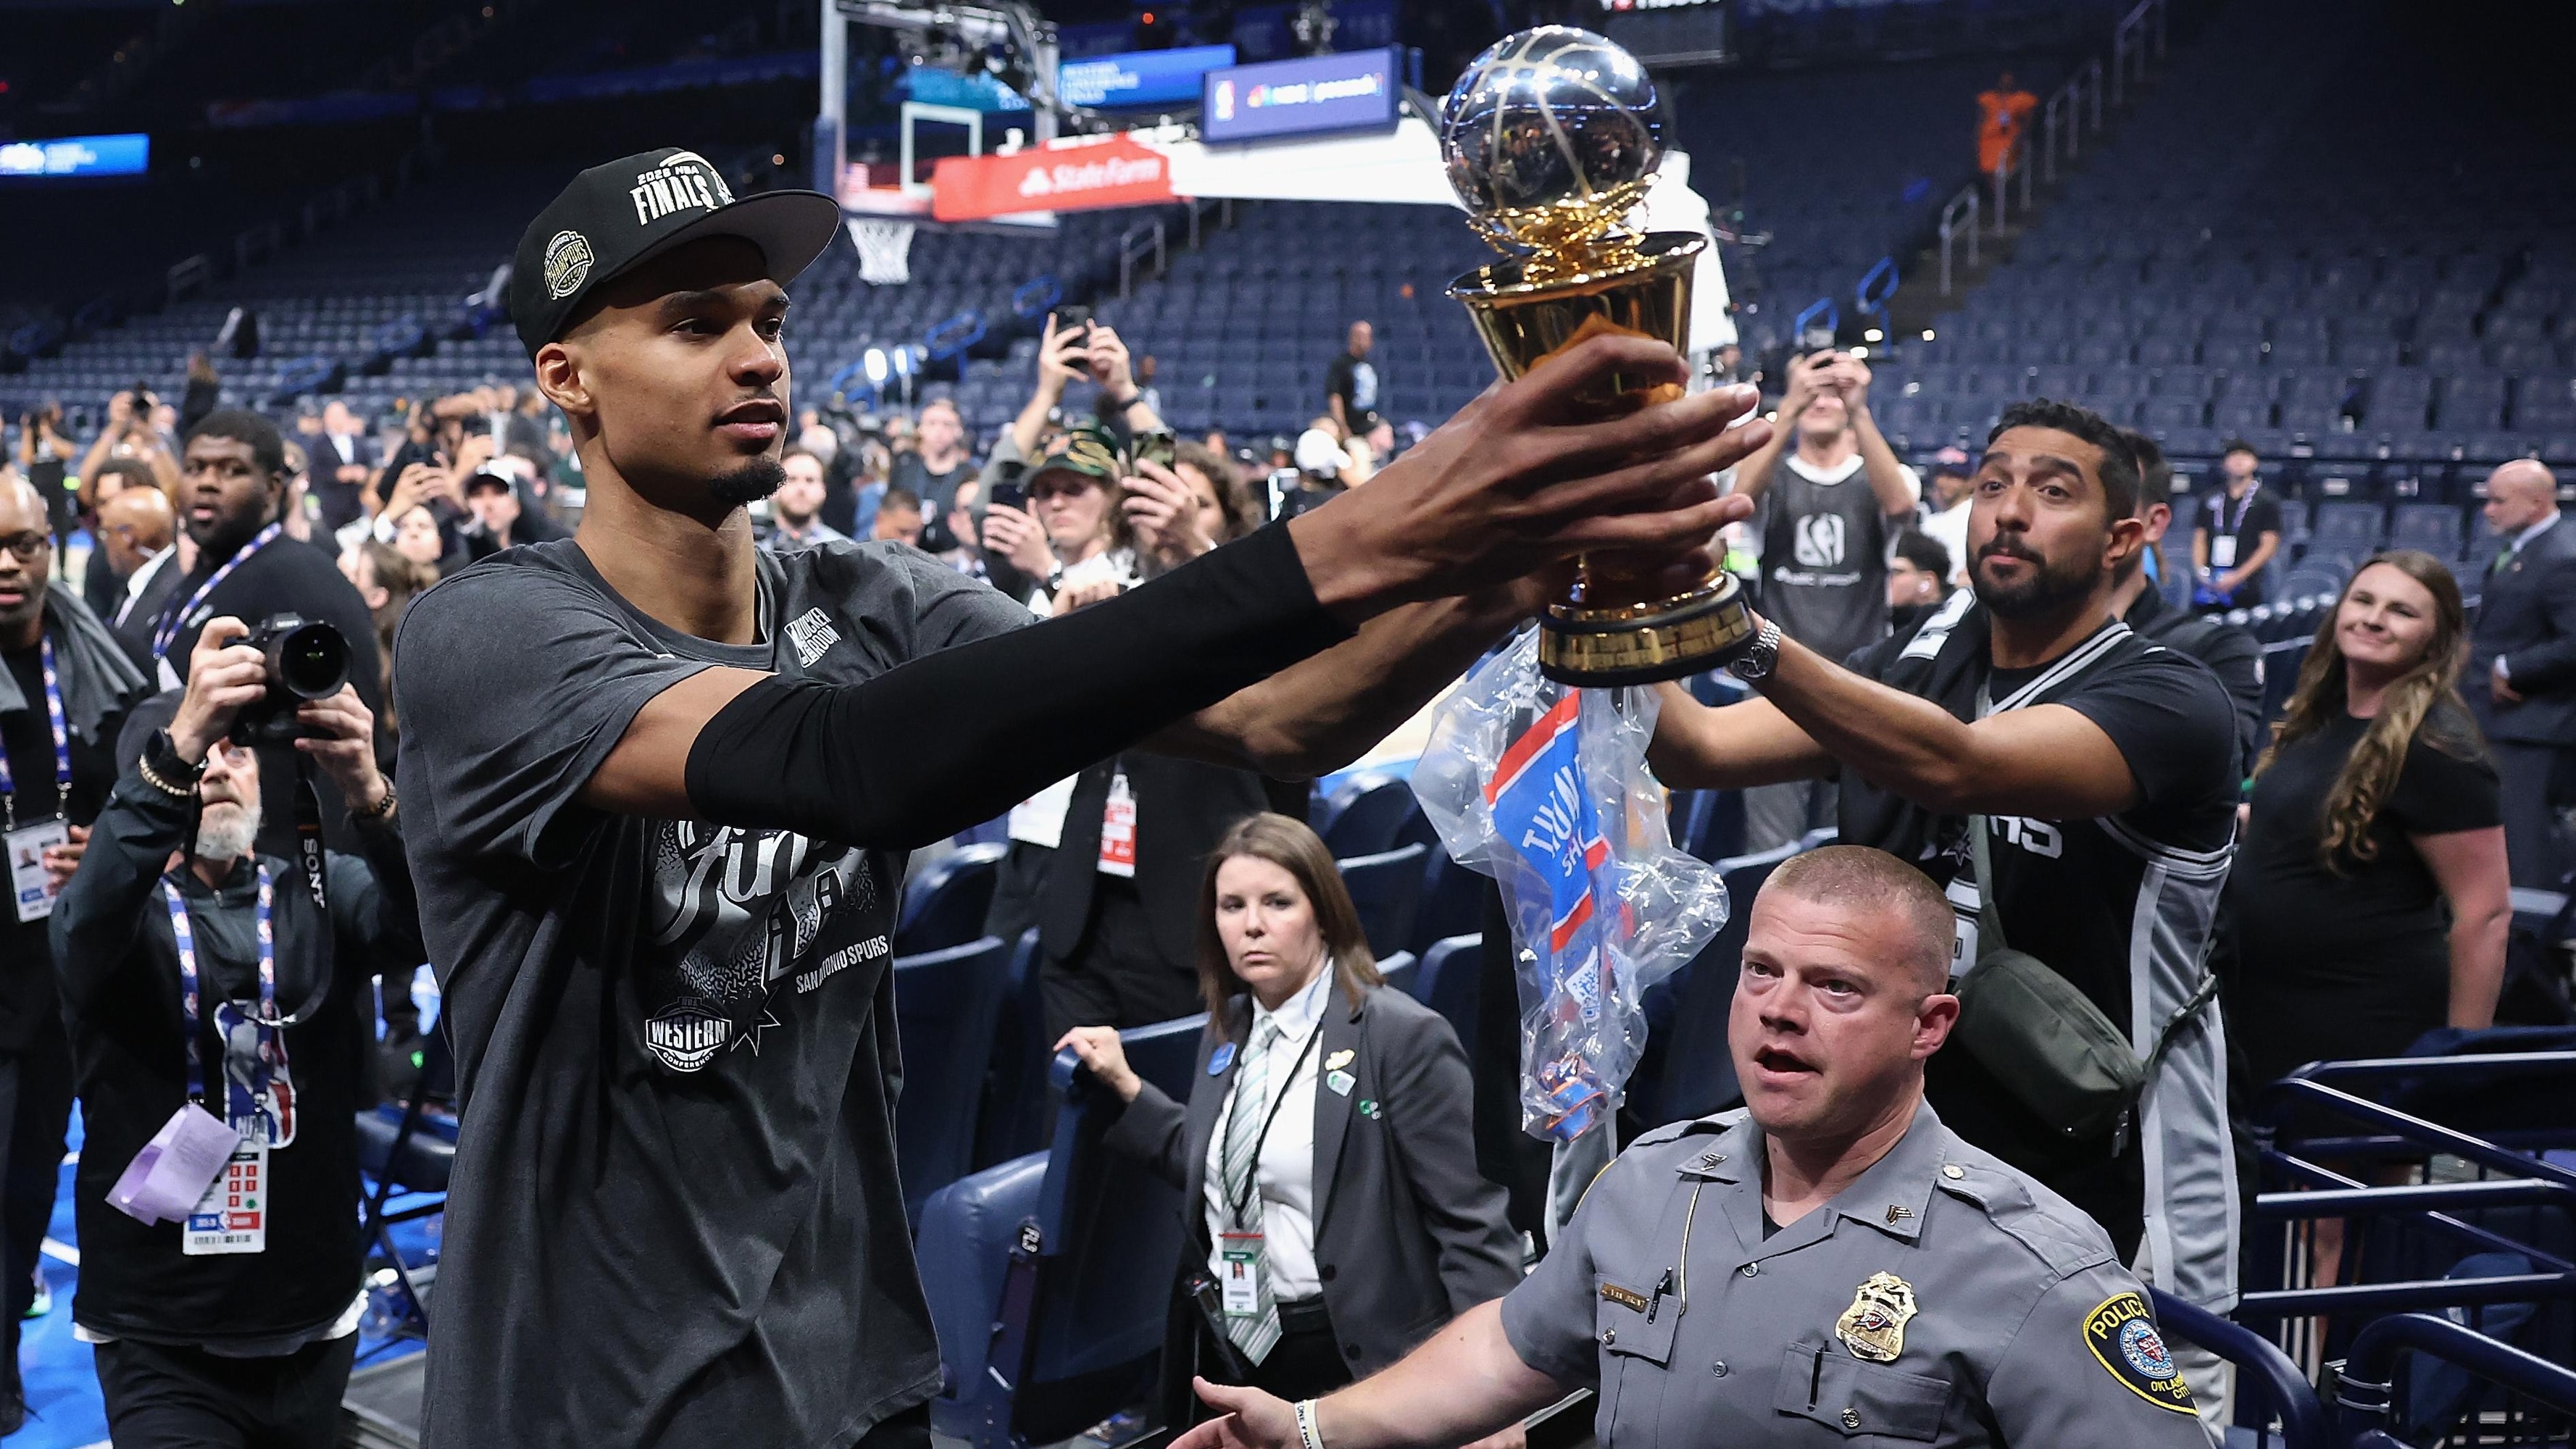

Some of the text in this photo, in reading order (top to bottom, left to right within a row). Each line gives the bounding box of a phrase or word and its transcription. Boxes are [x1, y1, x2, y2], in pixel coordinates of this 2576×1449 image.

[637, 165, 699, 185] 2026 NBA
[629, 175, 715, 226] FINALS
[547, 242, 588, 291] CHAMPIONS
[796, 607, 833, 640] LOCKER
[806, 625, 842, 657] ROOM
[304, 838, 325, 909] SONY
[796, 970, 819, 994] SAN
[846, 935, 888, 965] SPURS
[651, 1015, 725, 1051] WESTERN
[663, 1051, 714, 1069] CONFERENCE
[2091, 1299, 2151, 1340] POLICE
